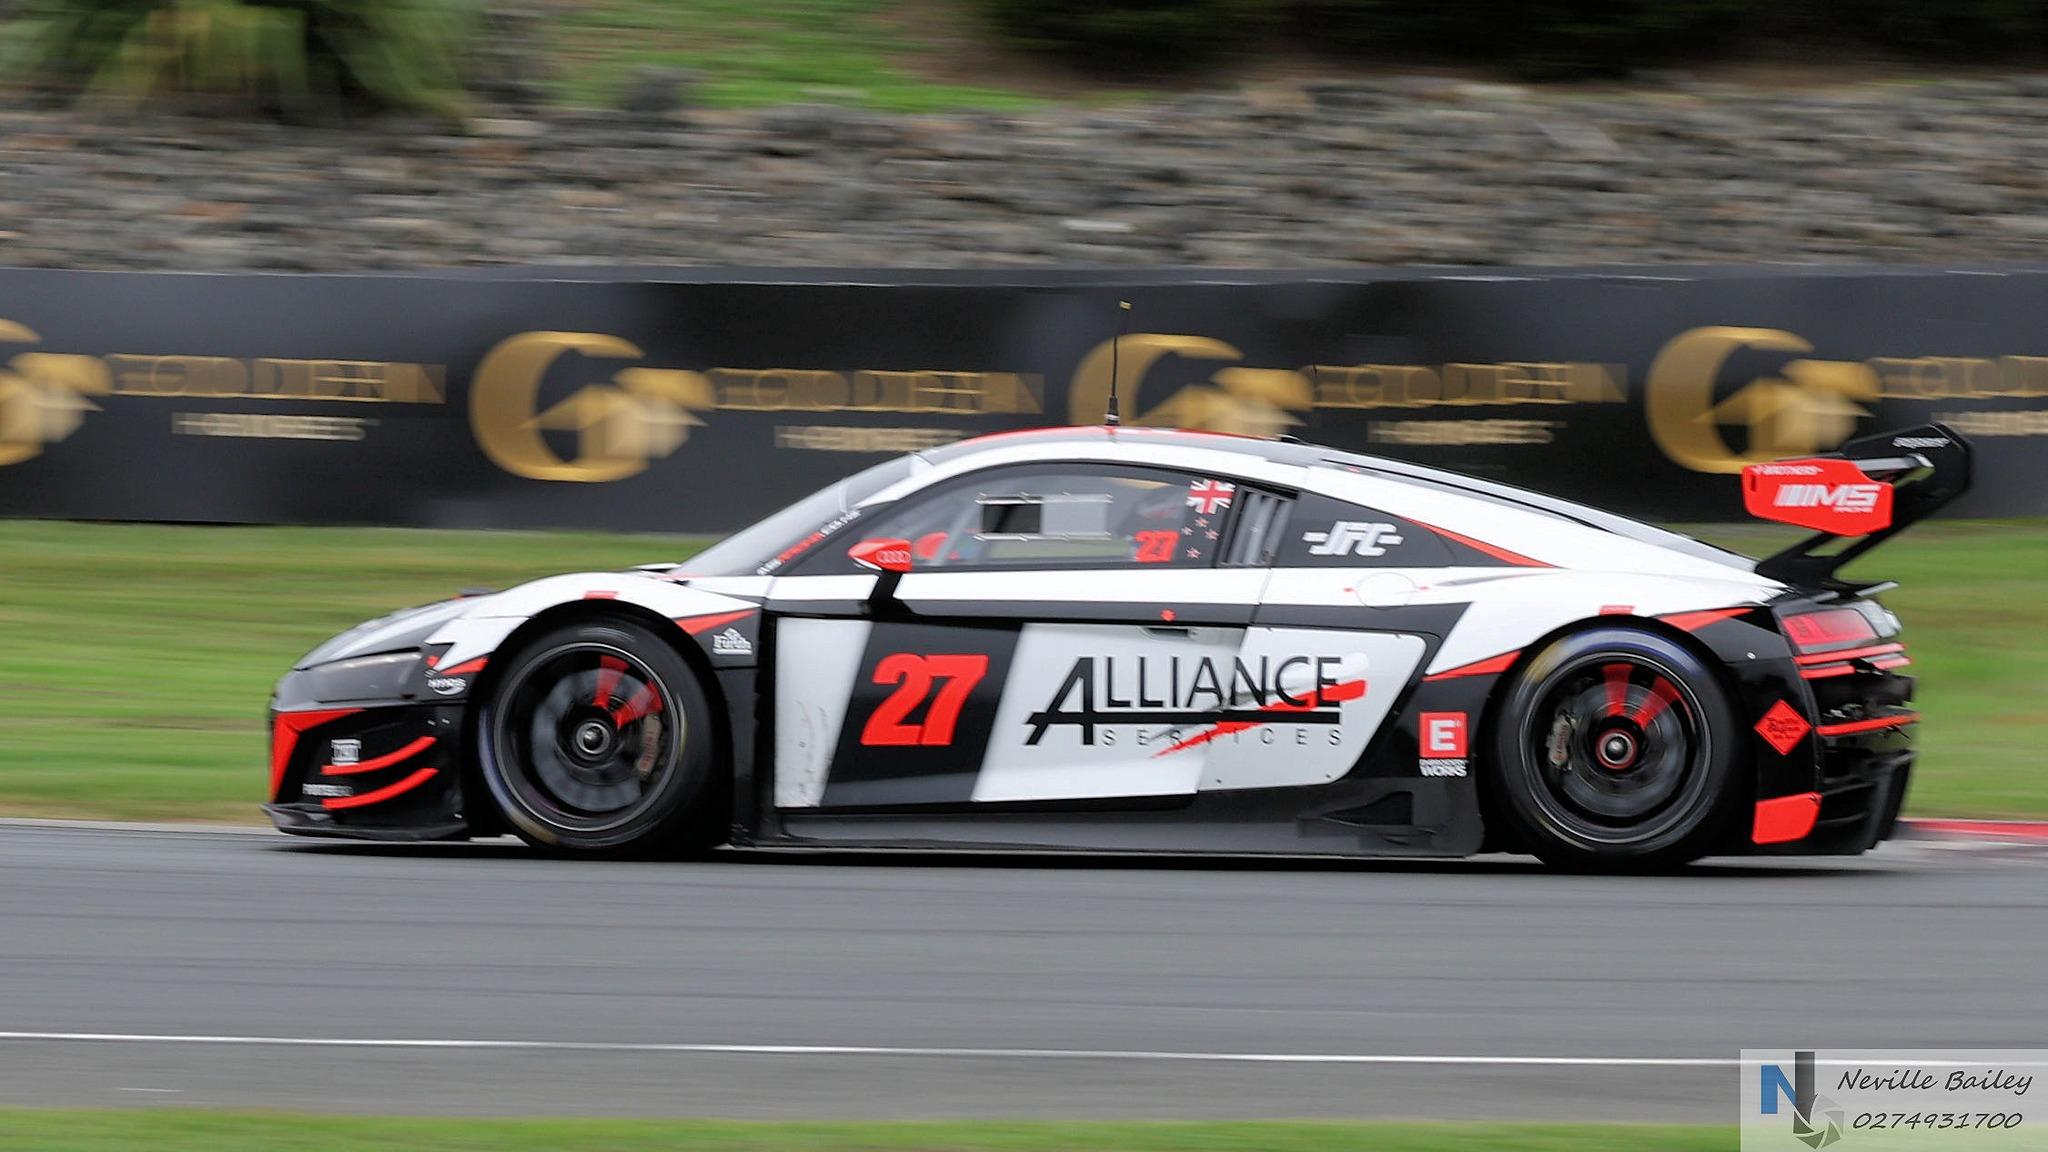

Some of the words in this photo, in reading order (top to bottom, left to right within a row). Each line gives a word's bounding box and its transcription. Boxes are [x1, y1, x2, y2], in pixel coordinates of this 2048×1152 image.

[1135, 529, 1180, 563] 27
[861, 652, 989, 746] 27
[1024, 656, 1343, 745] ALLIANCE
[1429, 719, 1457, 751] E
